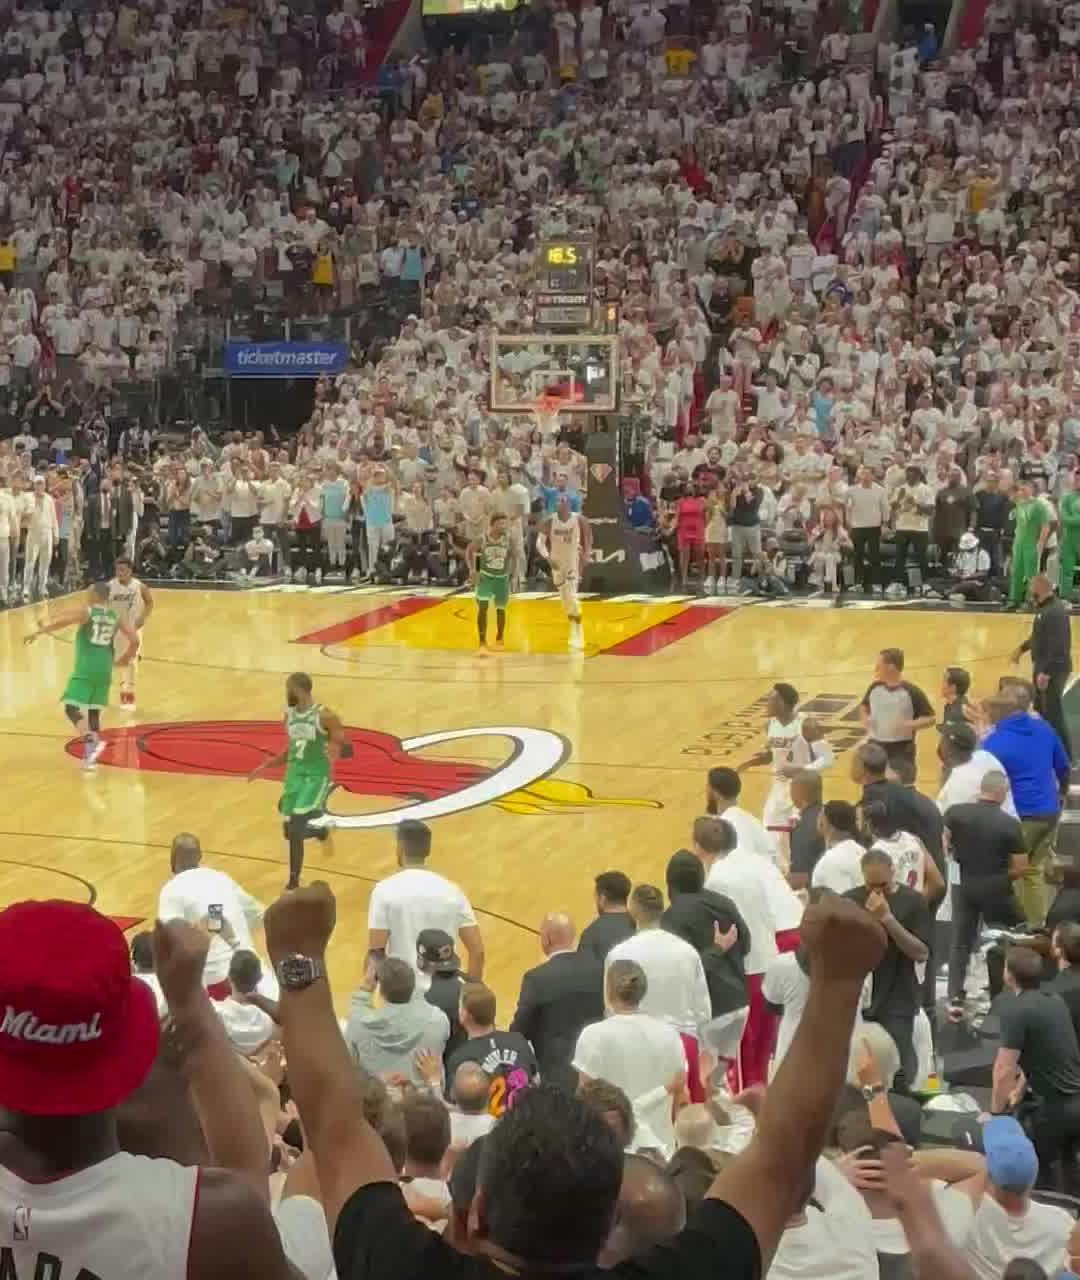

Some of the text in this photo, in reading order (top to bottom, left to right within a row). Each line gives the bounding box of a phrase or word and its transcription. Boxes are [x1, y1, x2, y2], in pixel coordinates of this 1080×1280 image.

[238, 348, 337, 366] ticketmaster
[90, 622, 116, 646] 12
[295, 740, 307, 760] 7
